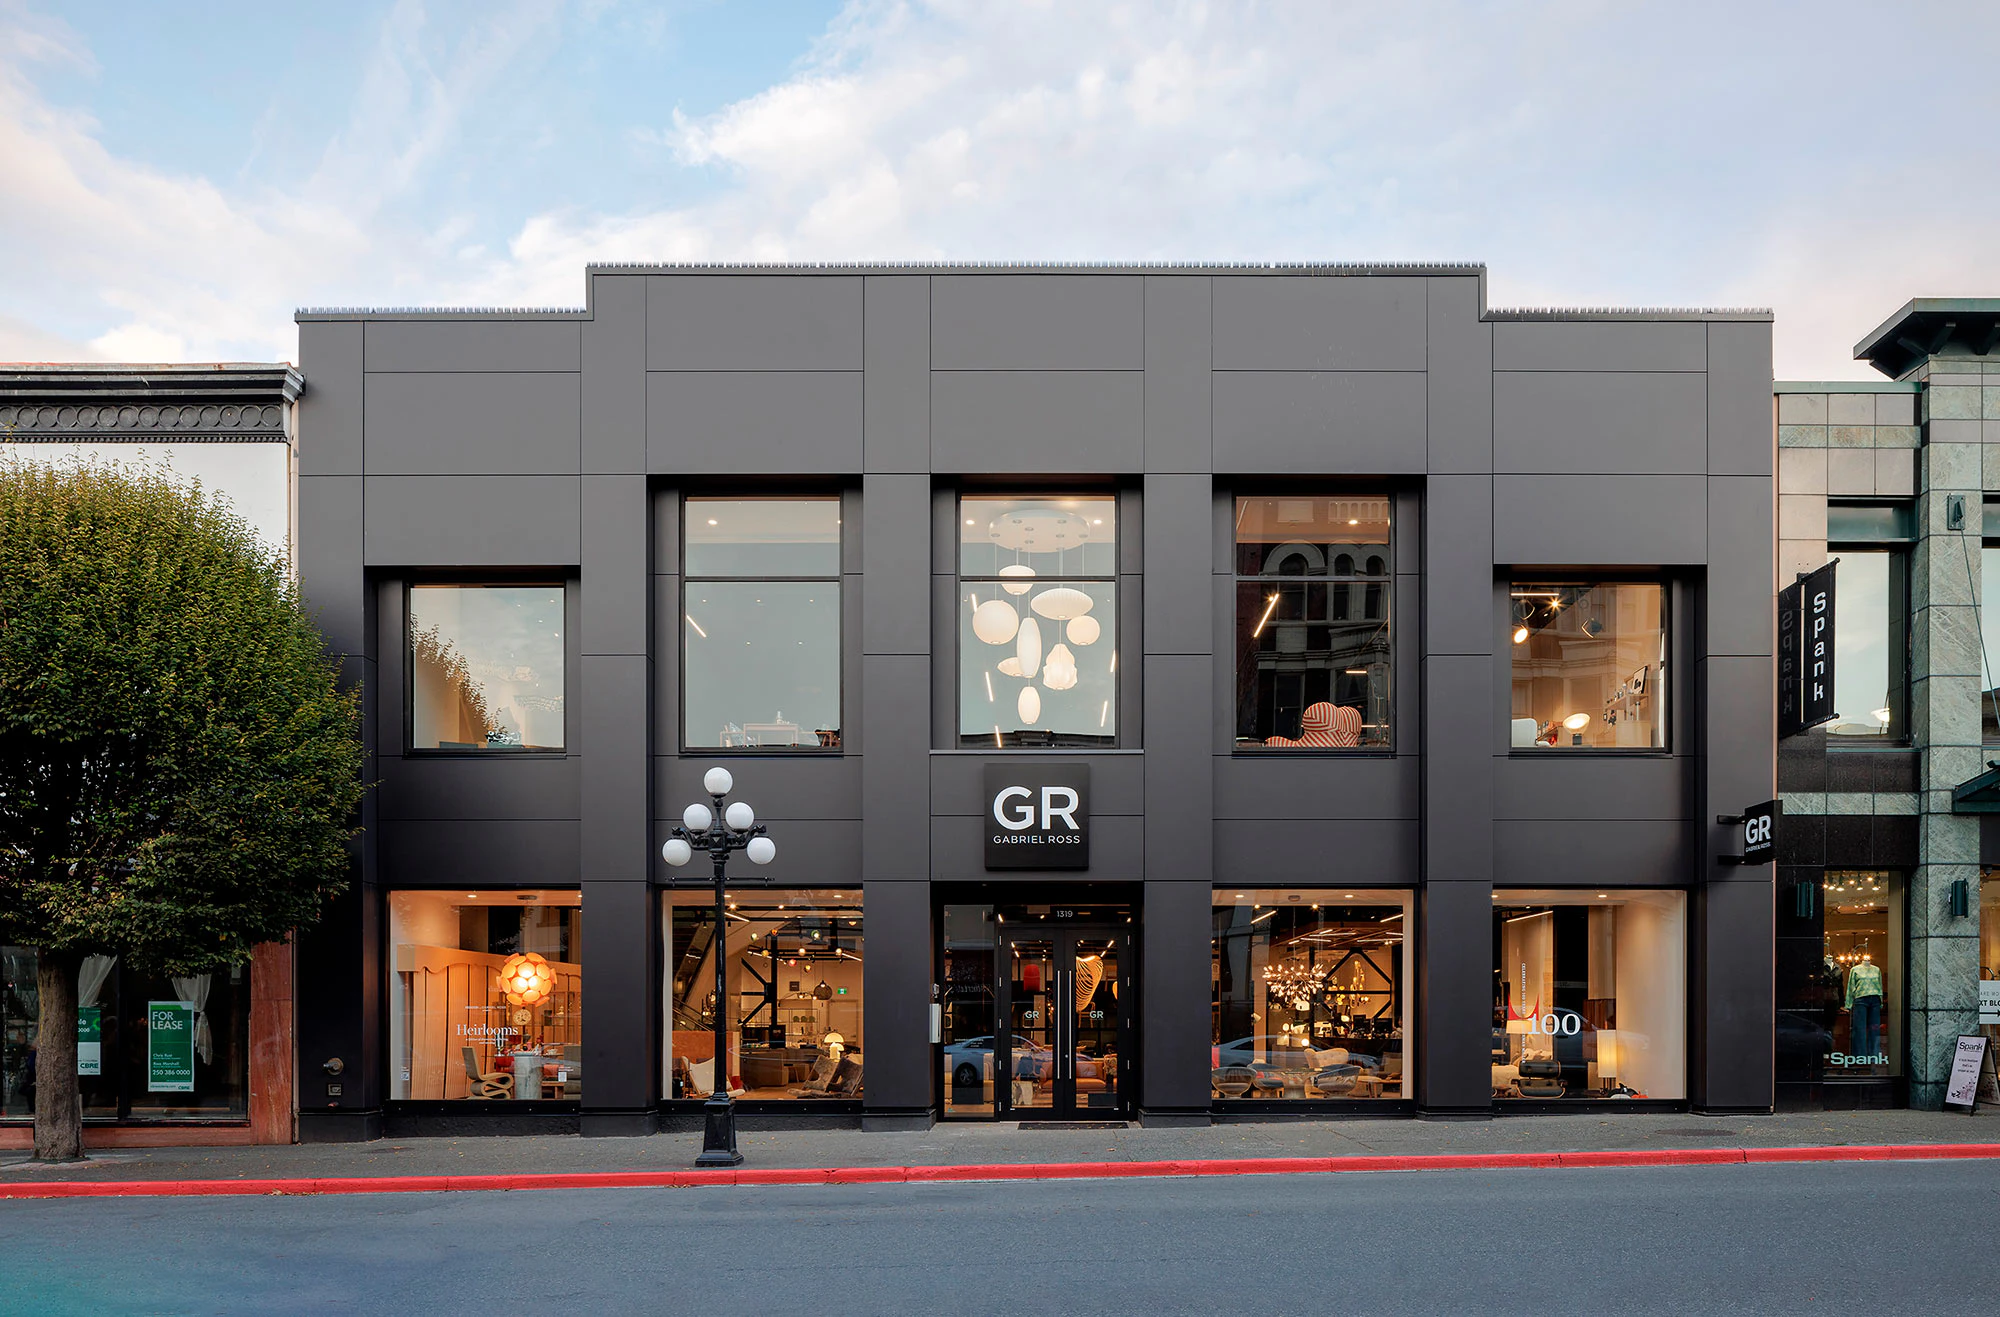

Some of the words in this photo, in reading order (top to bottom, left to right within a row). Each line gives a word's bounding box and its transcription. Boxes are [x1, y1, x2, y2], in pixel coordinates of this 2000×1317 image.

[1813, 591, 1826, 702] Spank
[993, 786, 1080, 831] GR
[1745, 815, 1772, 844] GR
[993, 835, 1045, 844] GABRIEL
[1048, 835, 1081, 844] ROSS
[1056, 910, 1073, 918] 1319
[152, 1011, 174, 1021] FOR
[1025, 1010, 1040, 1020] GR
[1089, 1010, 1104, 1020] GR
[152, 1020, 183, 1030] LEASE
[456, 1023, 519, 1036] Heirlooms
[1526, 1013, 1581, 1036] 100
[1959, 1041, 1983, 1052] Spank
[1830, 1052, 1889, 1068] Spank
